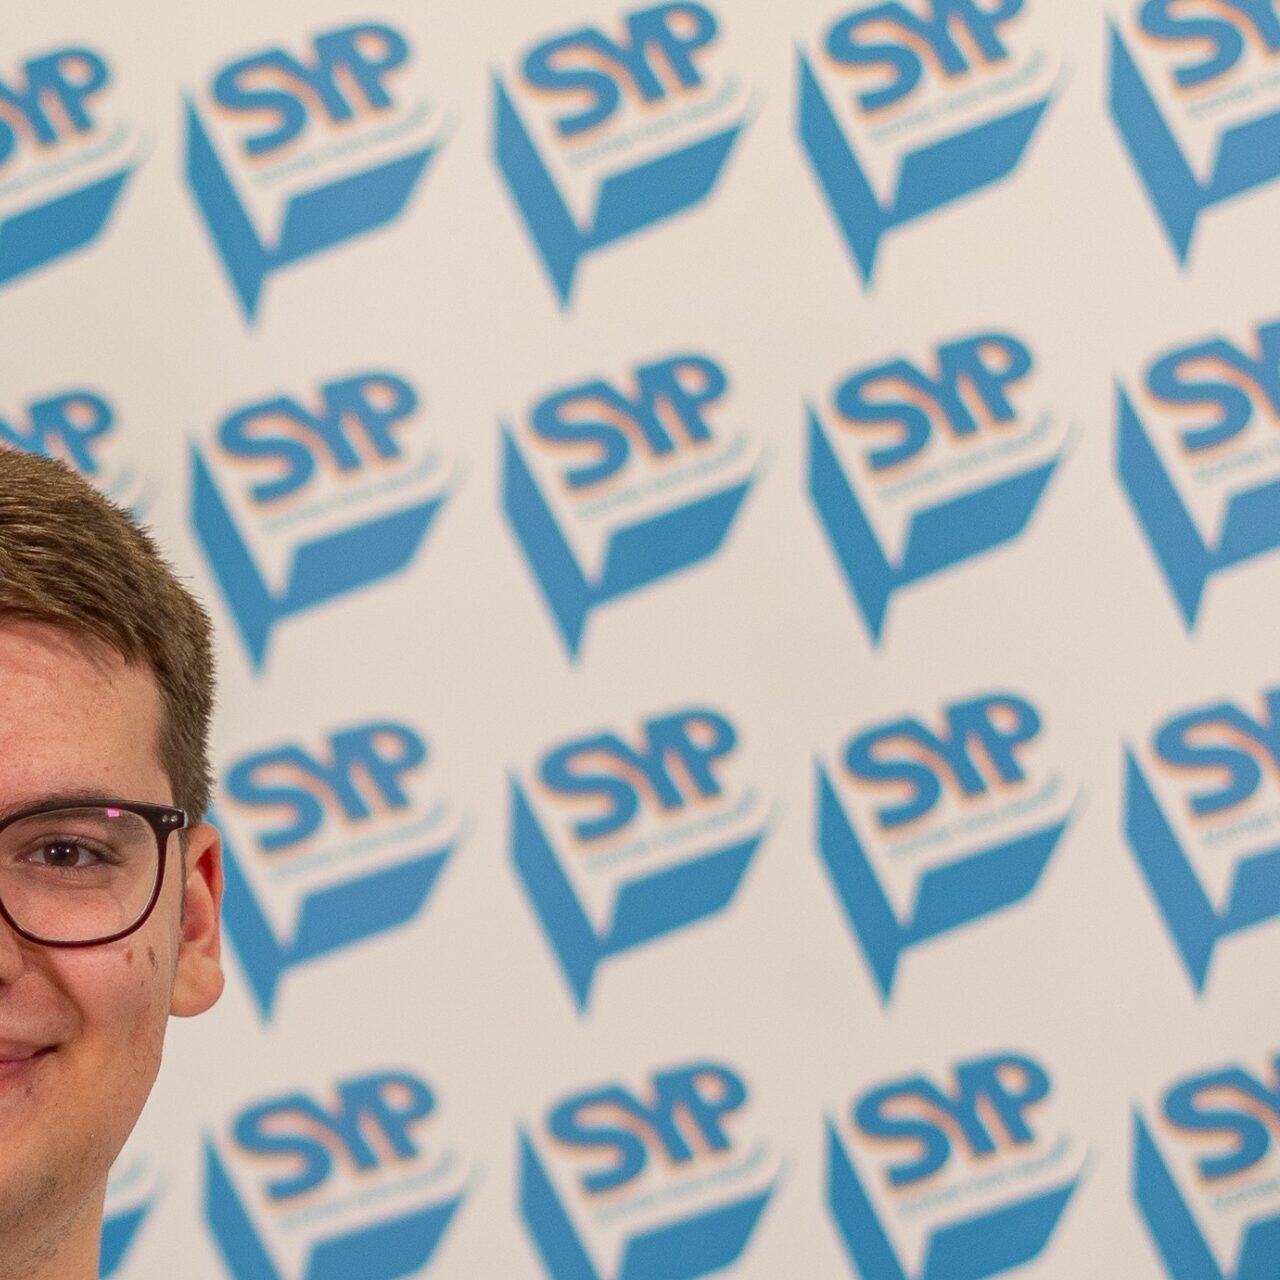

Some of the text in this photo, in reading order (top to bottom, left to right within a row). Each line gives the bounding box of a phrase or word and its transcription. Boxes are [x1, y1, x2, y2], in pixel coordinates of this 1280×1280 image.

[212, 23, 409, 153] SYP
[522, 0, 718, 133] SYP
[826, 0, 1025, 109] SYP
[218, 372, 418, 501] SYP
[532, 354, 728, 486] SYP
[835, 332, 1034, 468] SYP
[225, 723, 427, 849] SYP
[540, 709, 737, 839] SYP
[844, 693, 1042, 826] SYP
[233, 1072, 436, 1197] SYP
[548, 1062, 748, 1191] SYP
[854, 1053, 1051, 1184] SYP
